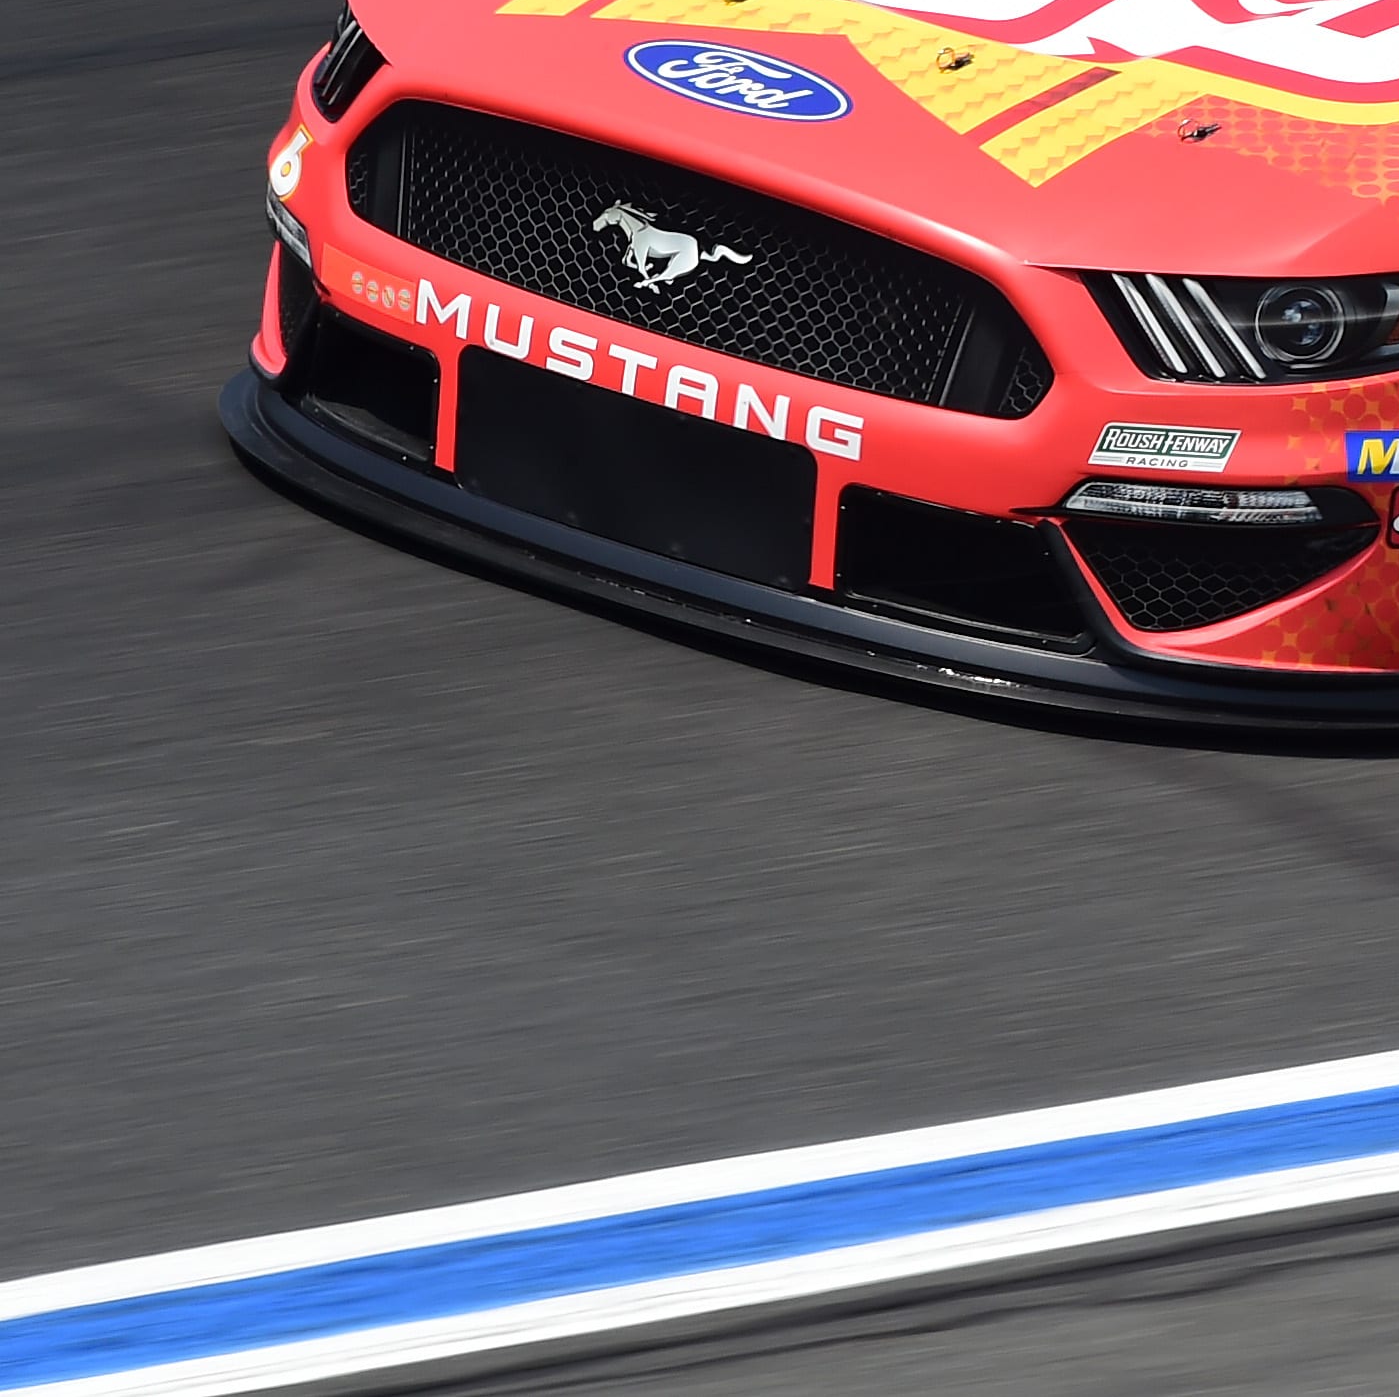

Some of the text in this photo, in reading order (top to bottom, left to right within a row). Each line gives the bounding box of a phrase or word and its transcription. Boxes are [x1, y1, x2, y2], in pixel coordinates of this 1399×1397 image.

[657, 45, 812, 114] Ford
[270, 126, 311, 199] 6
[415, 278, 865, 462] MUSTANG
[1102, 427, 1232, 458] ROUSH FENWAY
[1125, 456, 1190, 469] RACING
